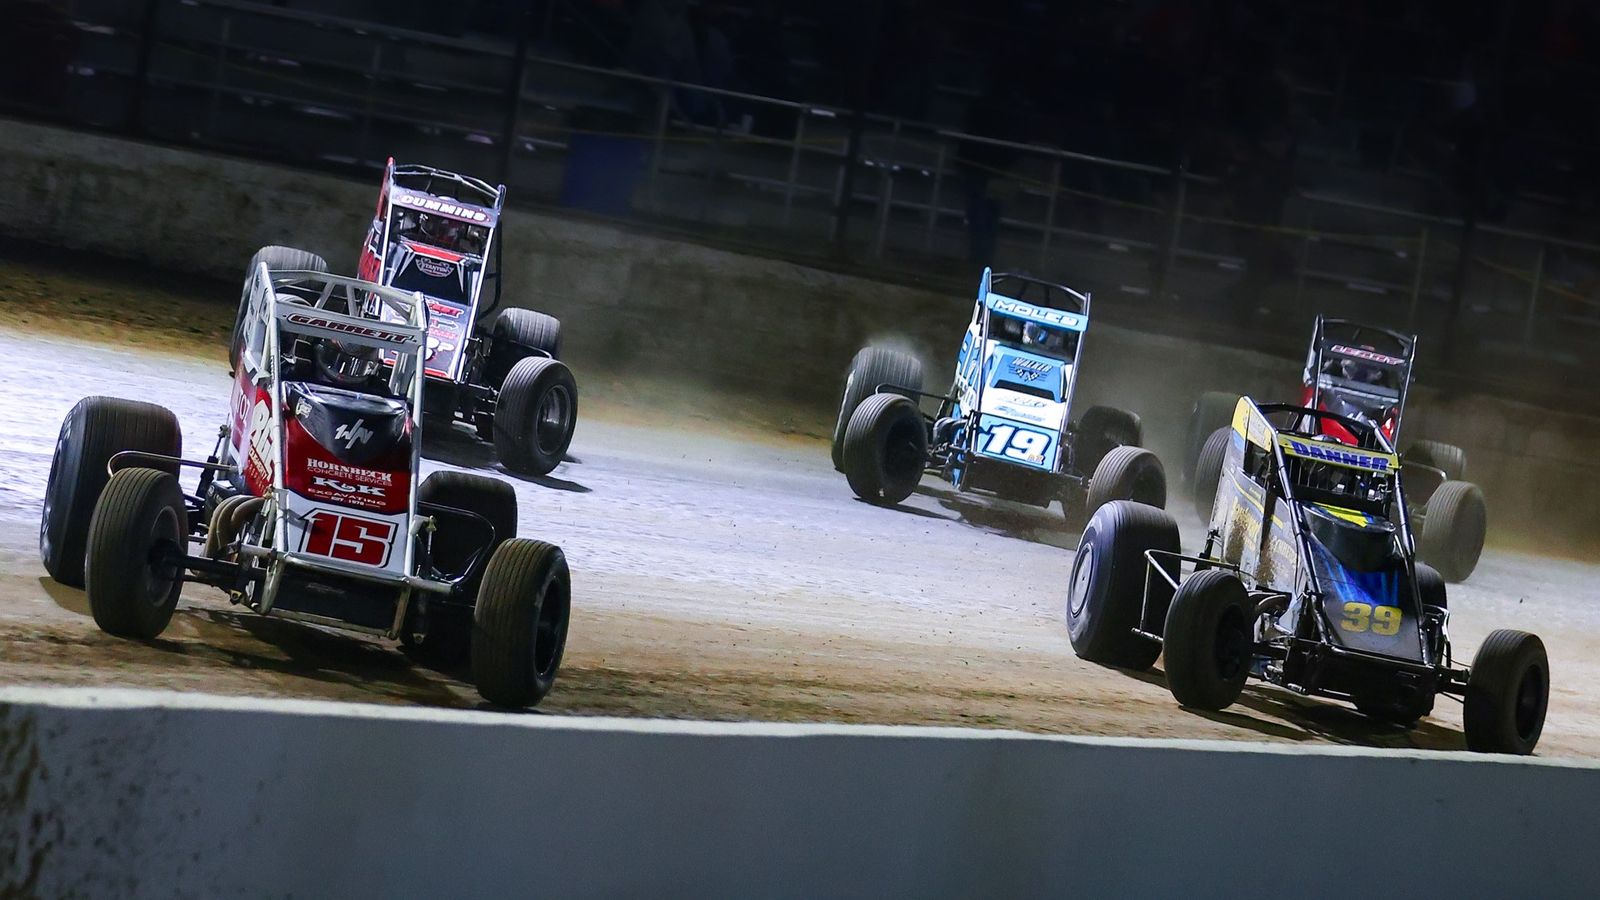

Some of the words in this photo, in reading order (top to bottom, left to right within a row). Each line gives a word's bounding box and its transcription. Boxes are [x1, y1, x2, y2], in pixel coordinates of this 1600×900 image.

[400, 194, 487, 222] CUMMINS
[287, 312, 410, 344] GARRETT
[982, 423, 1052, 461] 19
[1289, 441, 1390, 471] DANNER
[307, 457, 392, 482] HORNBECK
[307, 466, 353, 479] CONCRETE
[355, 475, 393, 487] SERVICES
[308, 487, 387, 506] EXCAVATING
[299, 508, 398, 568] 15
[1340, 601, 1402, 636] 39
